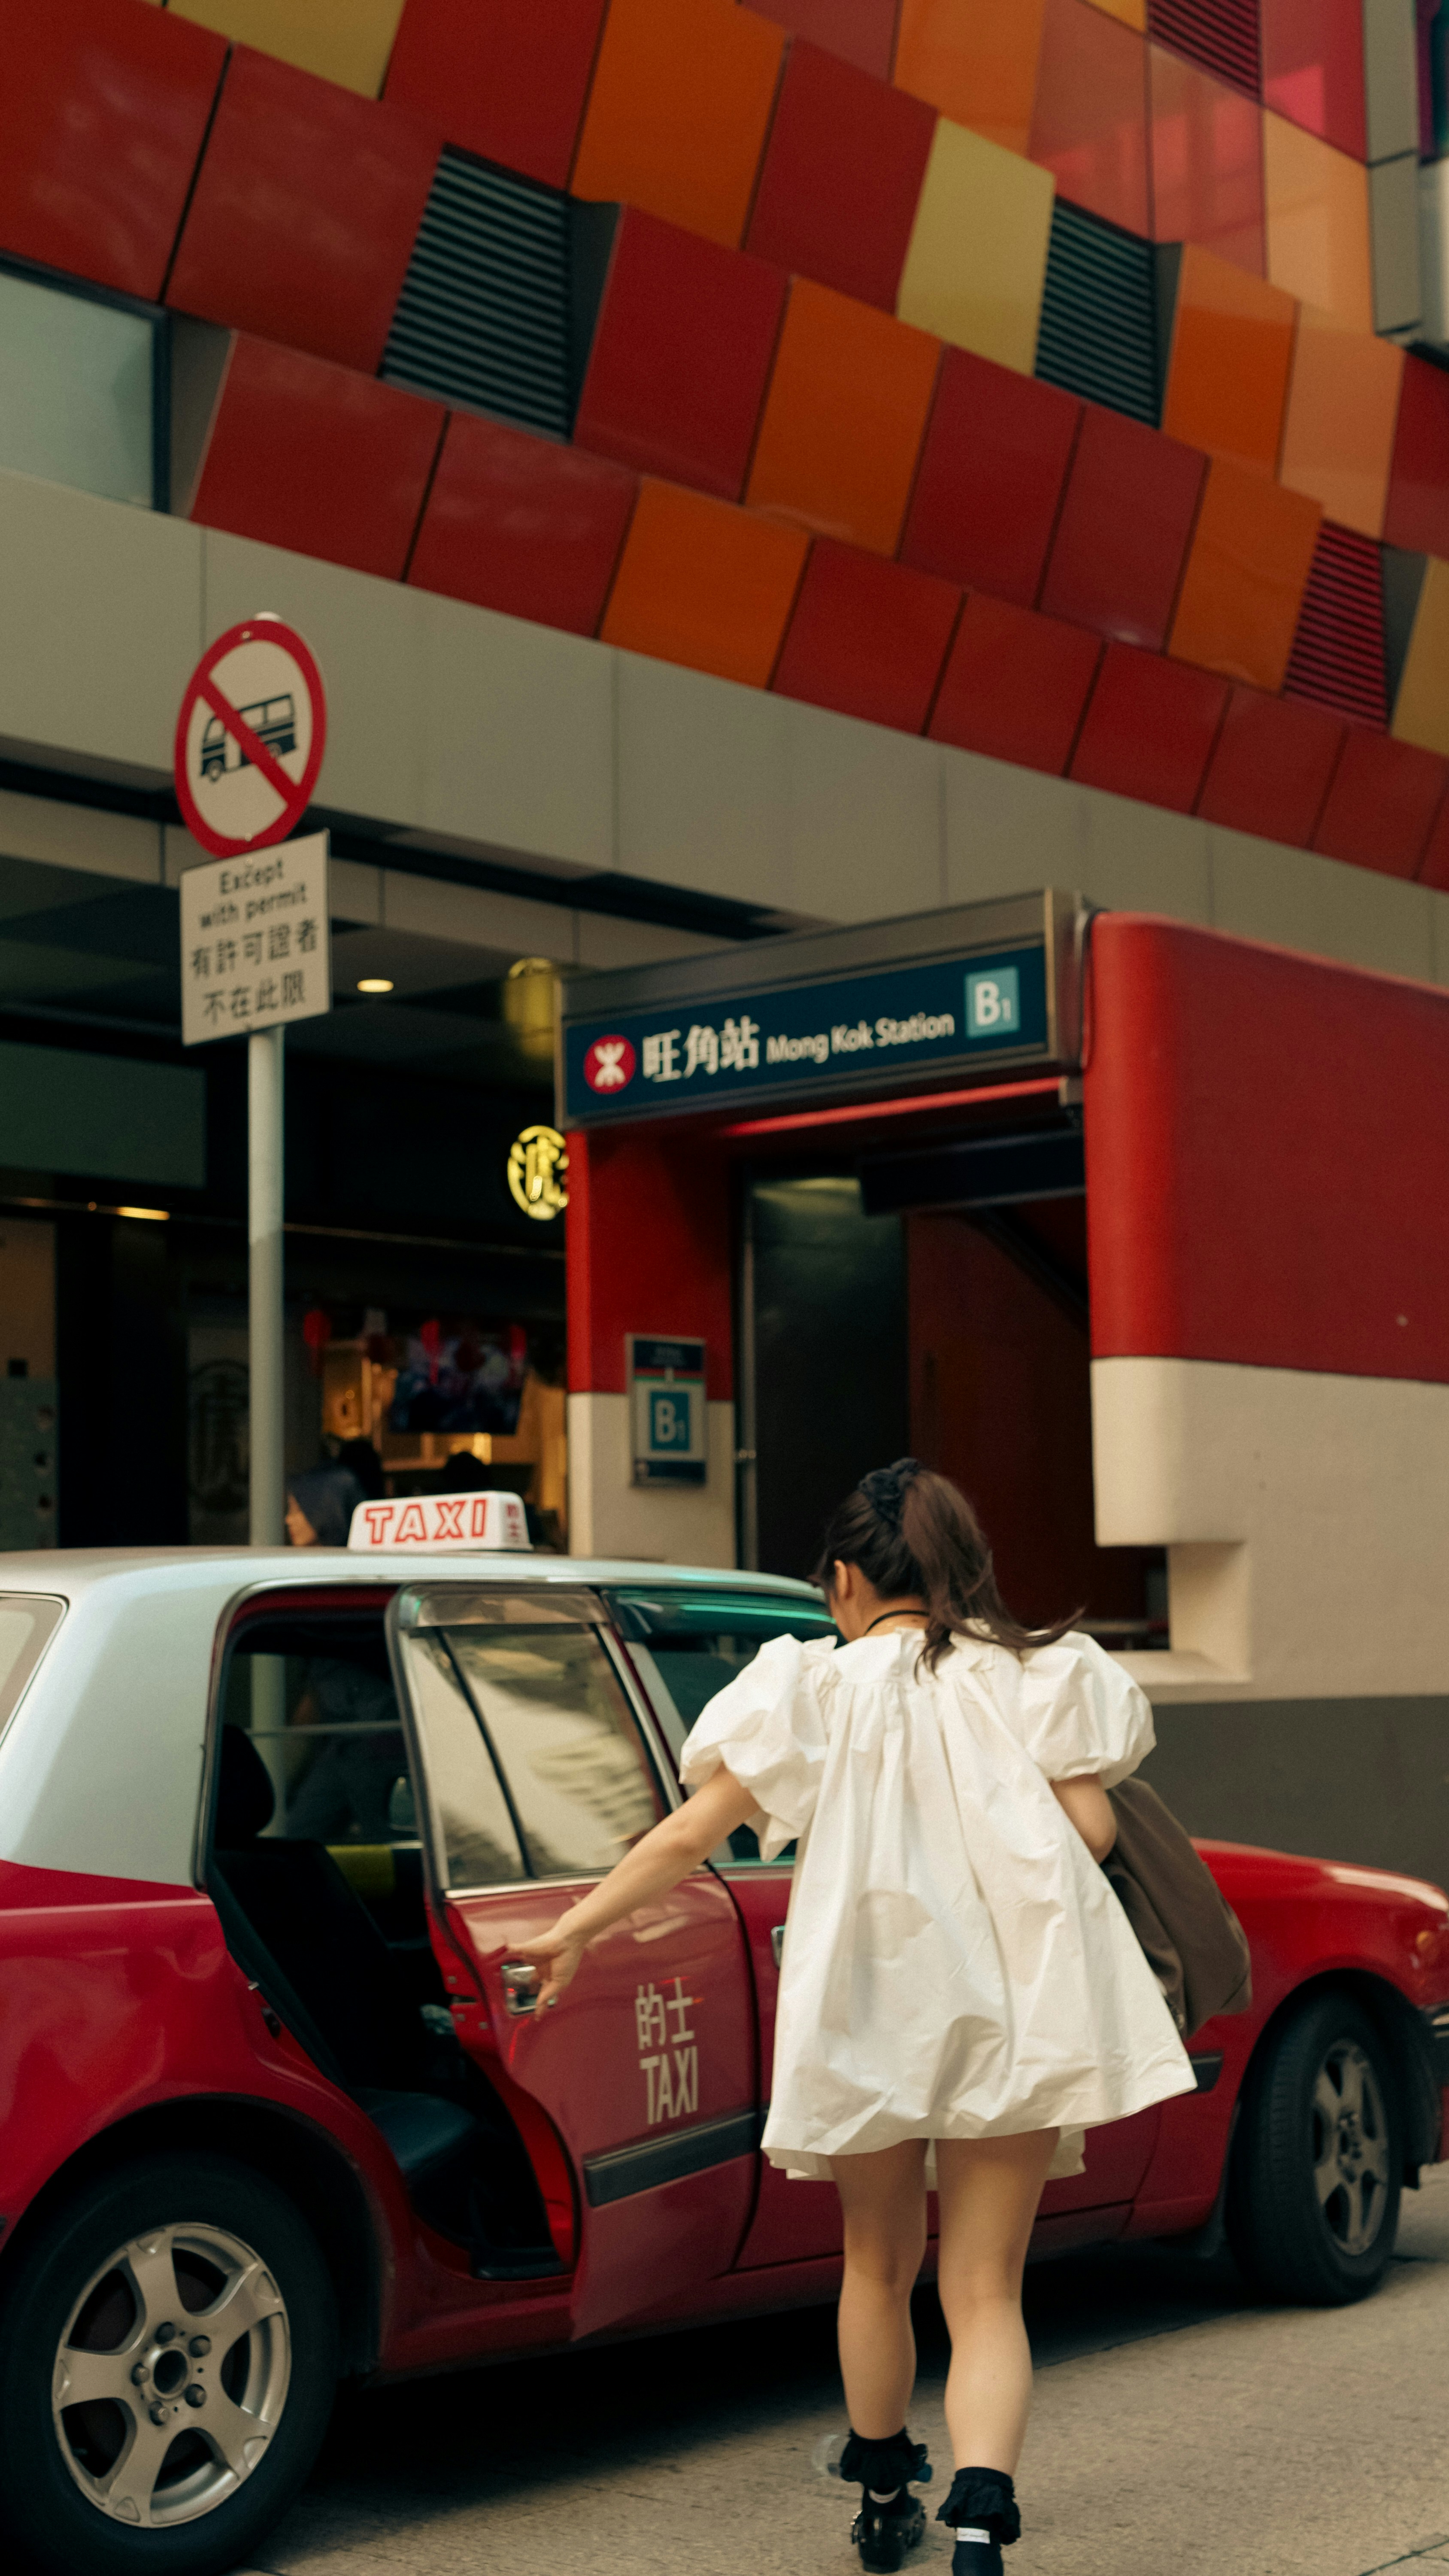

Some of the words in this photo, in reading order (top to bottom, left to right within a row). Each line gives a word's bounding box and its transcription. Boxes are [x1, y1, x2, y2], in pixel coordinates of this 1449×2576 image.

[220, 857, 284, 895] Except
[200, 902, 238, 929] with
[246, 884, 307, 921] permit
[191, 919, 318, 981] 有許可證者
[203, 969, 304, 1024] 不在此限
[974, 981, 1012, 1025] B1
[642, 1015, 759, 1082] 旺角站
[766, 1034, 829, 1064] Mong
[832, 1019, 873, 1054] Kok
[876, 1011, 955, 1046] Station
[365, 1499, 486, 1544] TAXI
[635, 1976, 695, 2050] 的士
[640, 2045, 698, 2125] TAXI
